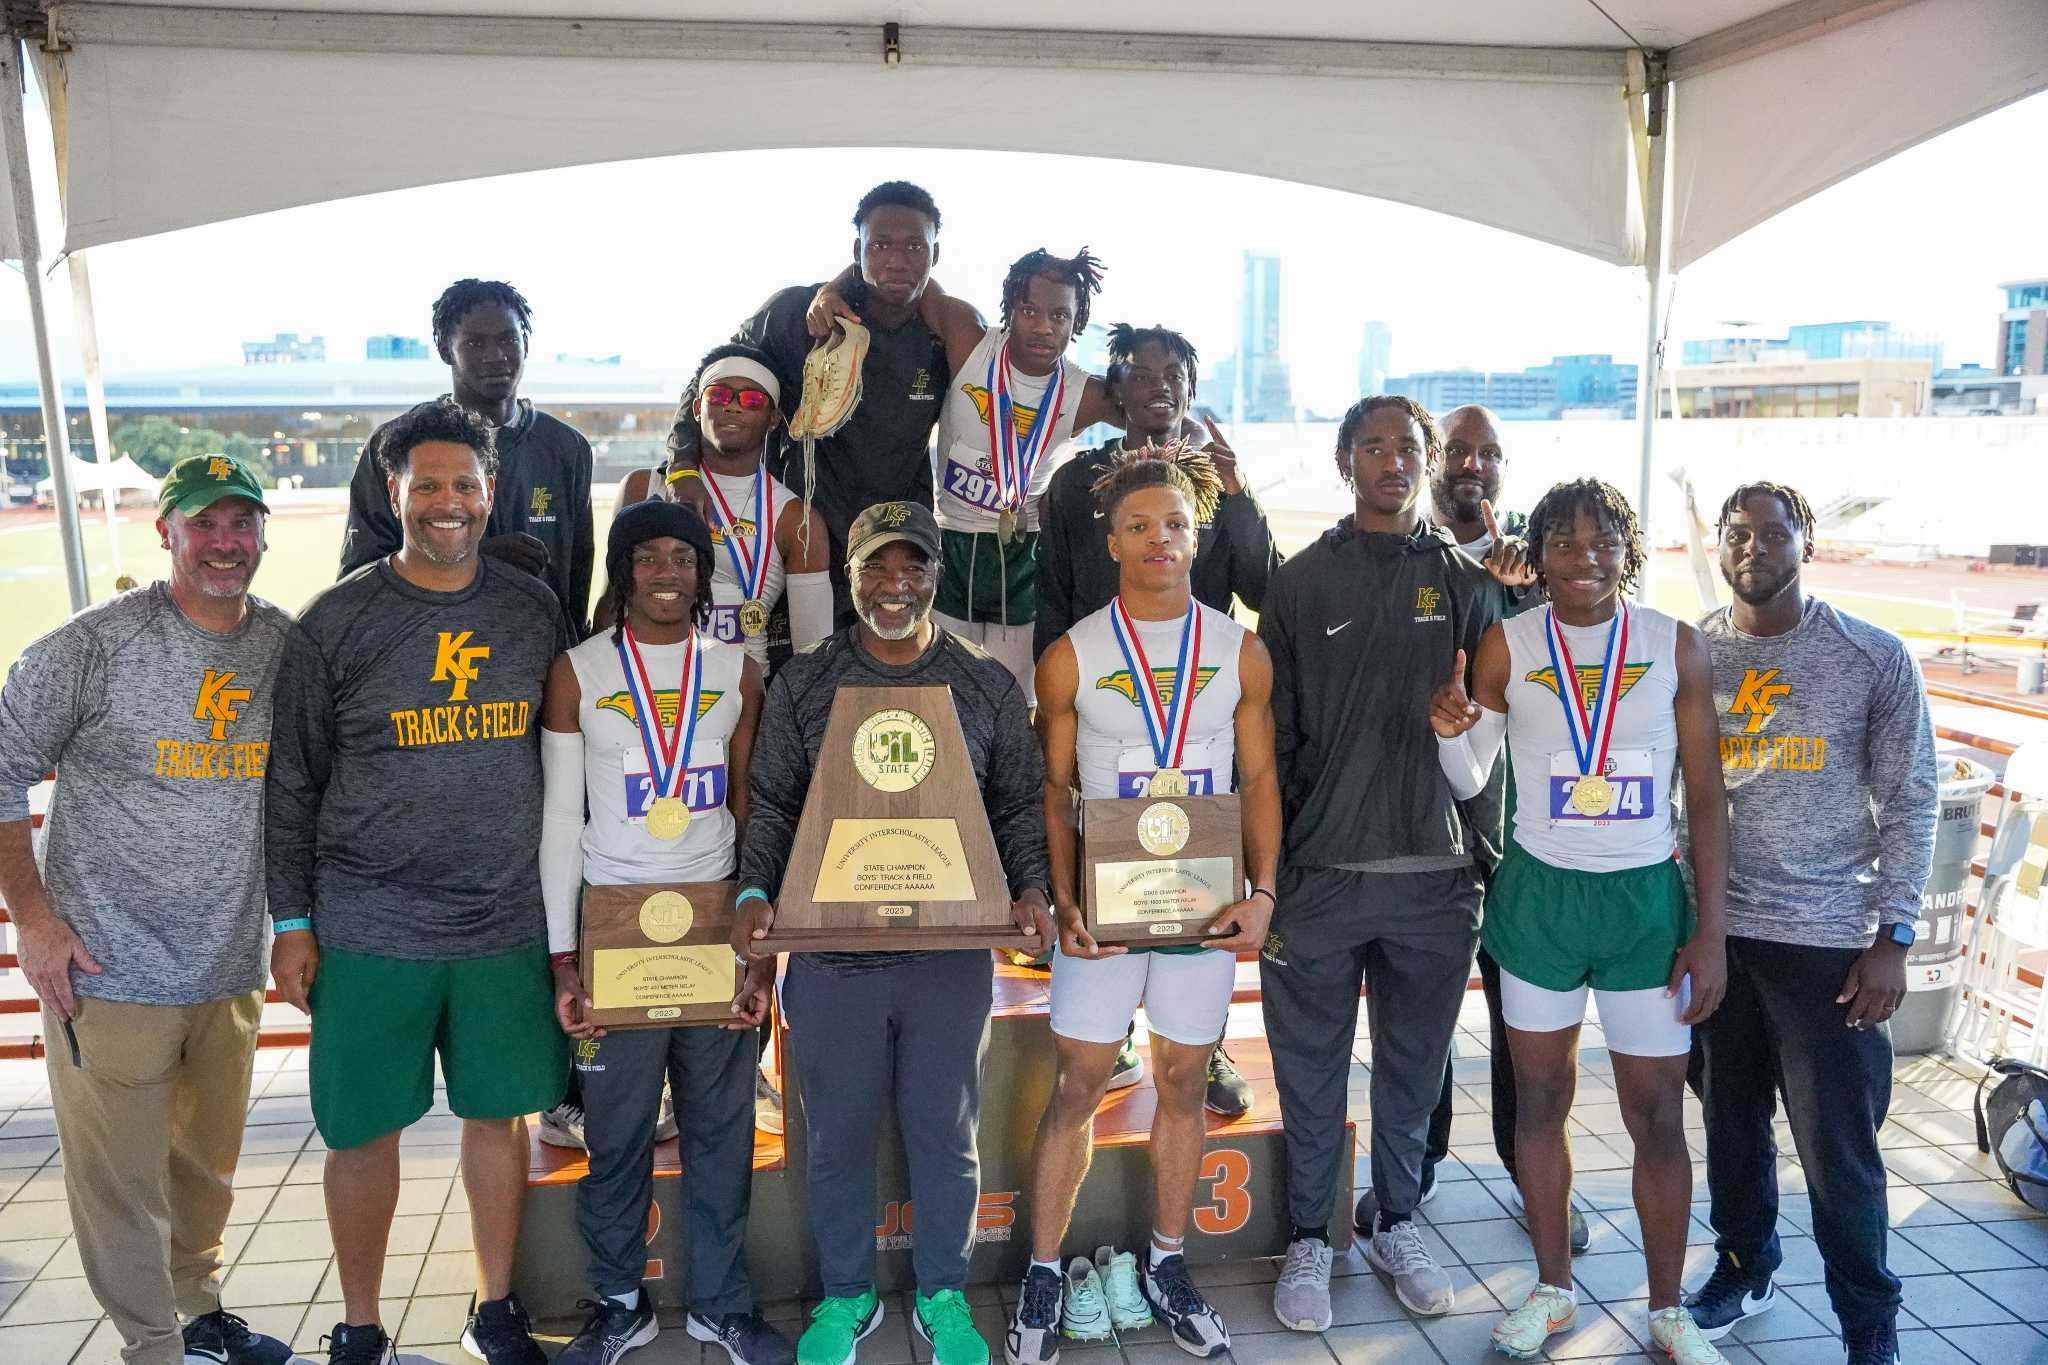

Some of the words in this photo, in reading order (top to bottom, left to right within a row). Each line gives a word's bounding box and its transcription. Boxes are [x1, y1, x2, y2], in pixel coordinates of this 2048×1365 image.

[208, 457, 236, 481] KF
[531, 488, 552, 516] KF
[884, 504, 911, 528] KF
[1416, 587, 1440, 615] KF
[430, 631, 490, 701] KF
[193, 669, 251, 741] KF
[1727, 668, 1792, 734] KF
[389, 705, 462, 747] TRACK
[465, 704, 478, 740] &
[481, 701, 529, 739] FIELD
[155, 739, 218, 779] TRACK
[232, 741, 269, 778] FIE
[870, 731, 918, 763] UIL
[1719, 736, 1752, 769] ACK
[1772, 735, 1825, 771] FIELD
[879, 765, 909, 773] STATE
[1132, 774, 1204, 797] 27
[640, 771, 714, 811] 271
[1562, 781, 1643, 815] 274
[836, 835, 869, 870] UNIVERSITY
[869, 828, 932, 846] INTERSCHOLASTIC
[931, 844, 952, 867] LEAGUE
[885, 907, 904, 915] 2023
[654, 1009, 673, 1017] 2023
[1193, 1149, 1250, 1234] 3
